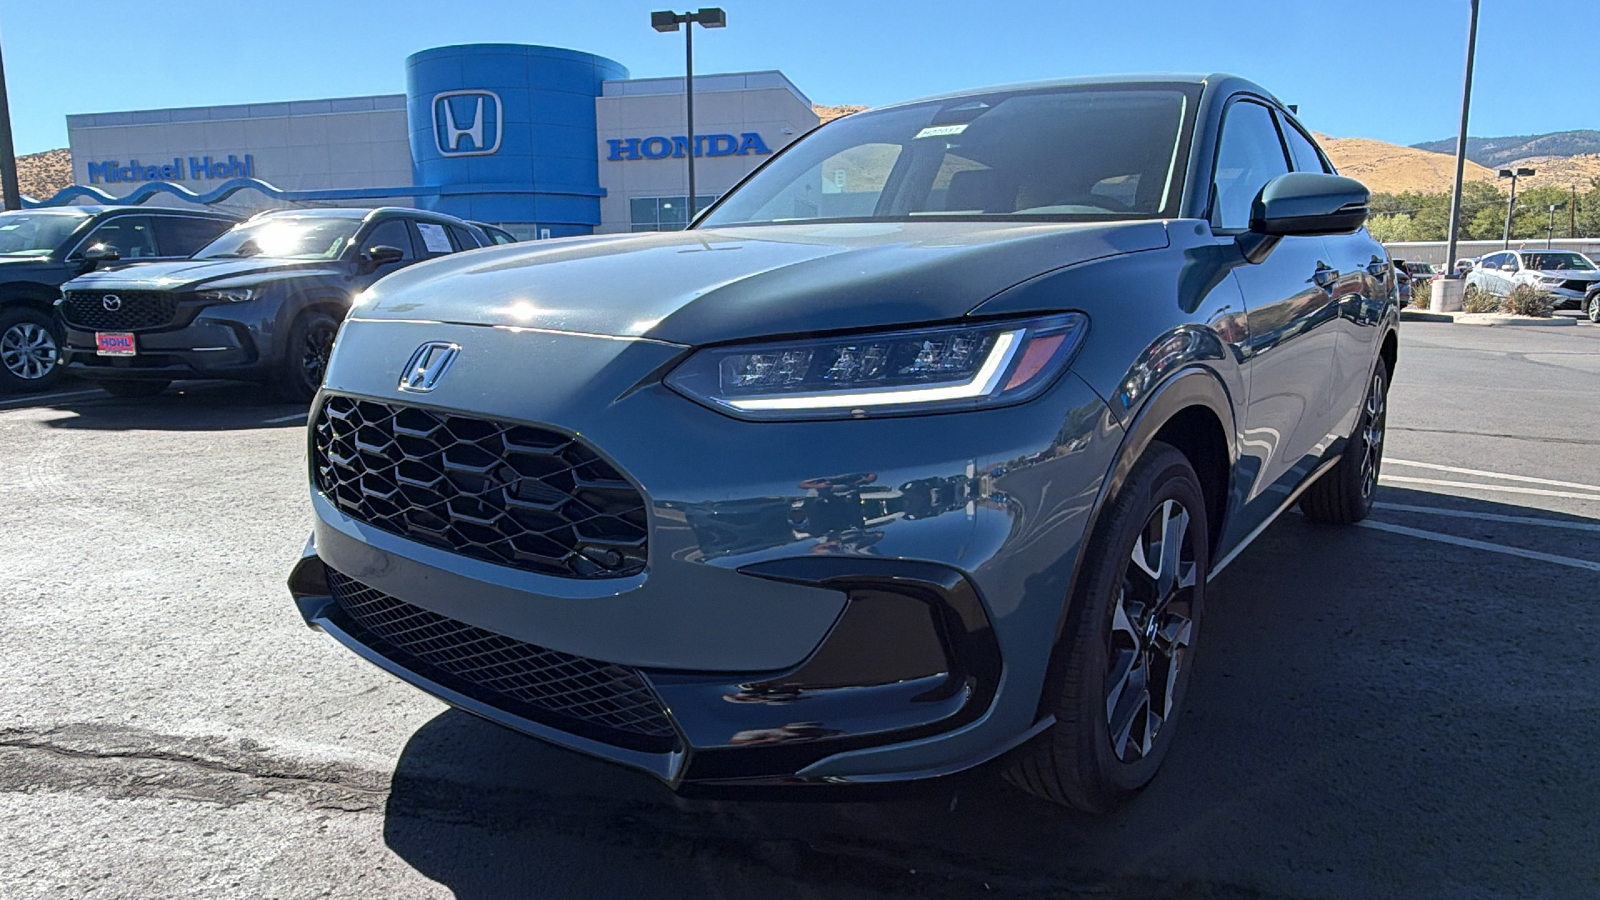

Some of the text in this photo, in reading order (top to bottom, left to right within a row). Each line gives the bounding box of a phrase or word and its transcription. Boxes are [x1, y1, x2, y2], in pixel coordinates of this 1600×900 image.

[606, 132, 773, 161] HONDA
[88, 154, 254, 184] Michael Hohl
[101, 337, 131, 347] HOHL
